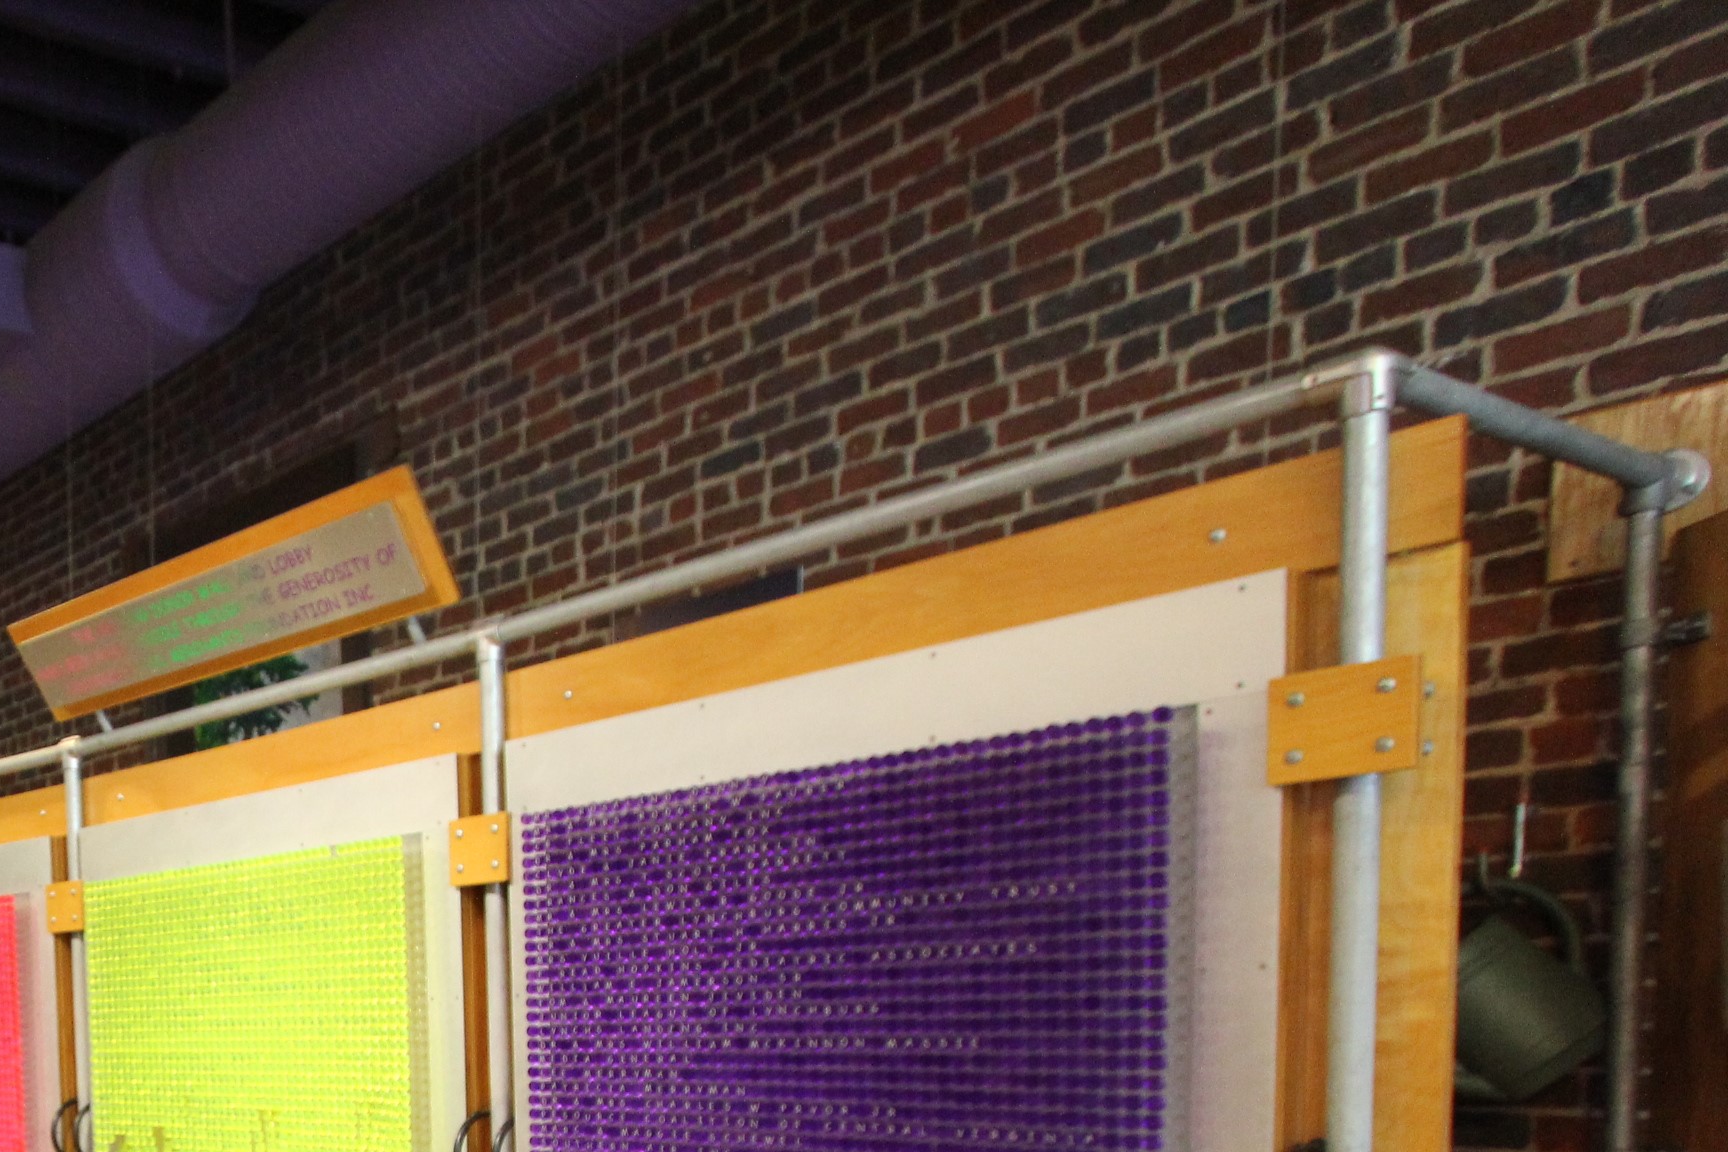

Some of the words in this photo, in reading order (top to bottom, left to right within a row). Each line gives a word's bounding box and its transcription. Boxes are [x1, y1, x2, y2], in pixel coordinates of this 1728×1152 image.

[266, 544, 315, 576] LOBBY
[275, 552, 373, 600] GENEROSITY
[374, 542, 400, 566] OF
[342, 583, 375, 607] INC
[638, 814, 726, 836] COMPANY
[590, 845, 622, 858] MRS
[591, 875, 623, 888] MRS
[592, 905, 623, 917] MRS
